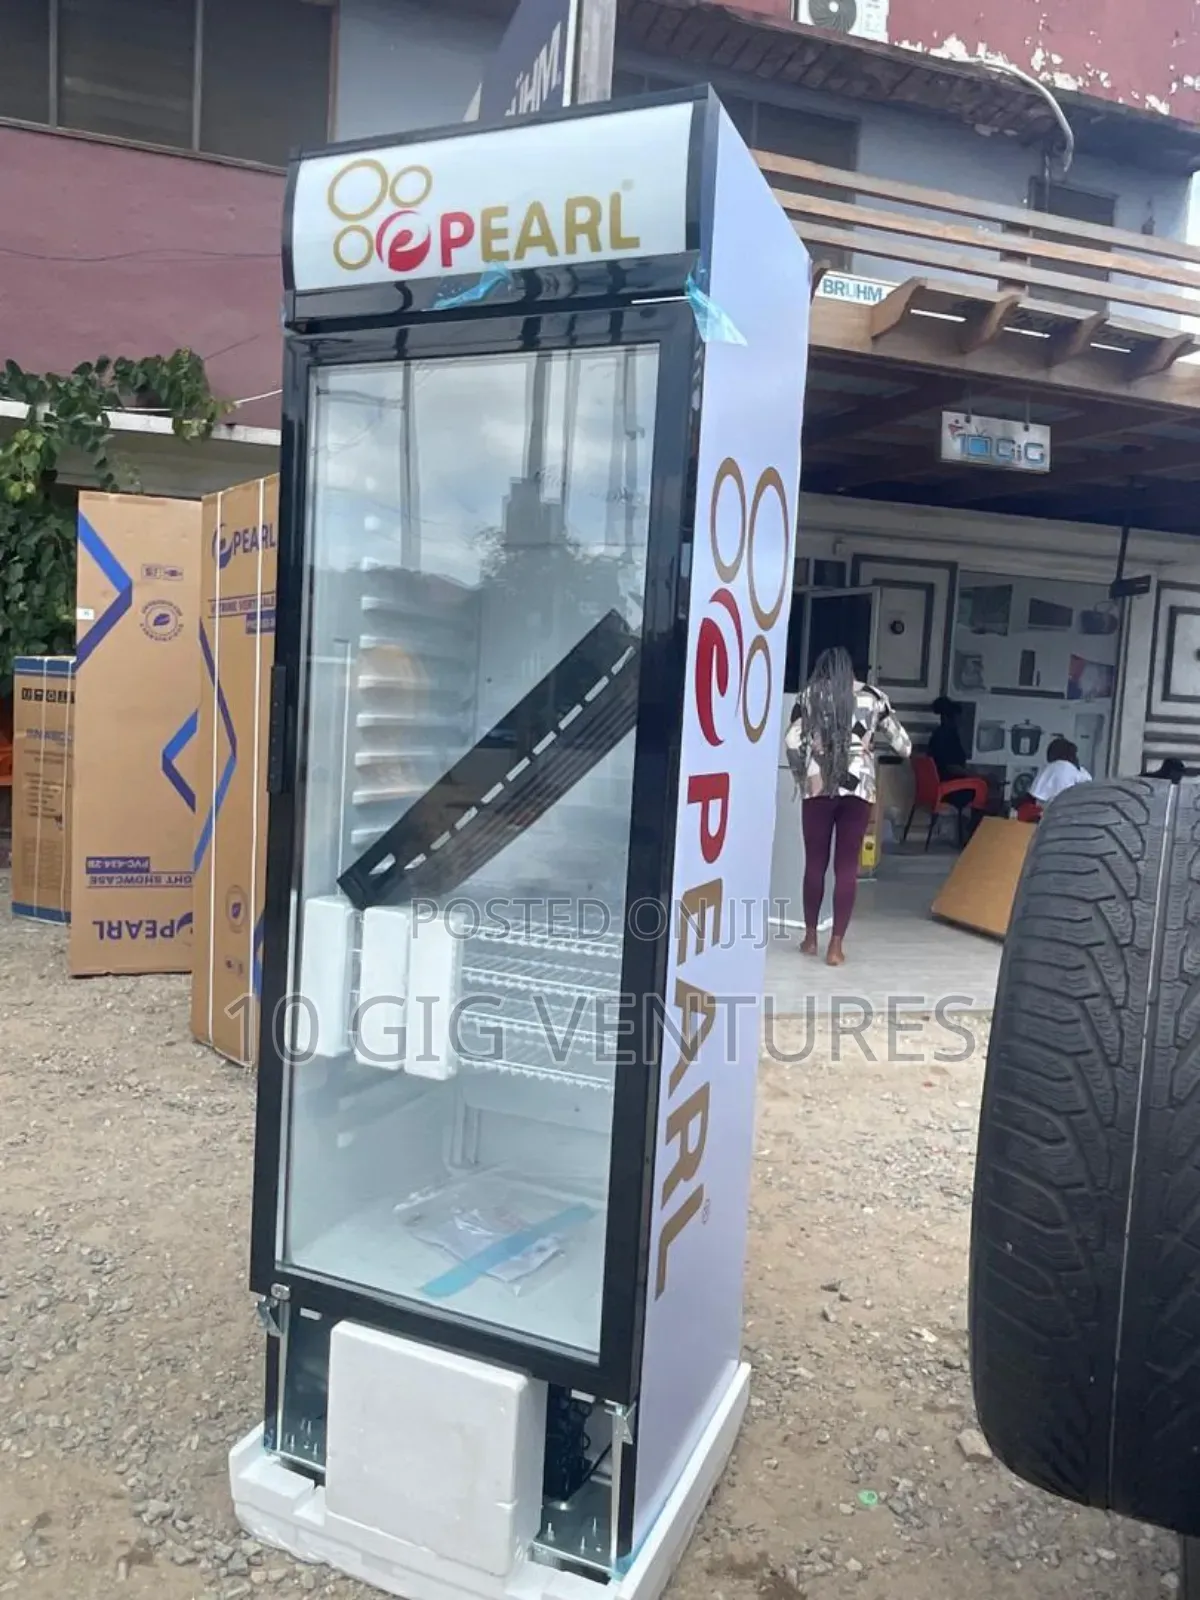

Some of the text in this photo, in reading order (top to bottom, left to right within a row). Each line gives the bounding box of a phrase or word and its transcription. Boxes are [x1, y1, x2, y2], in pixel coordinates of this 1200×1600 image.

[439, 190, 641, 268] PEARL
[233, 523, 276, 555] PEARL
[89, 875, 163, 886] SHOWCASE
[92, 919, 175, 941] PEARL
[655, 772, 730, 1301] PEARL
